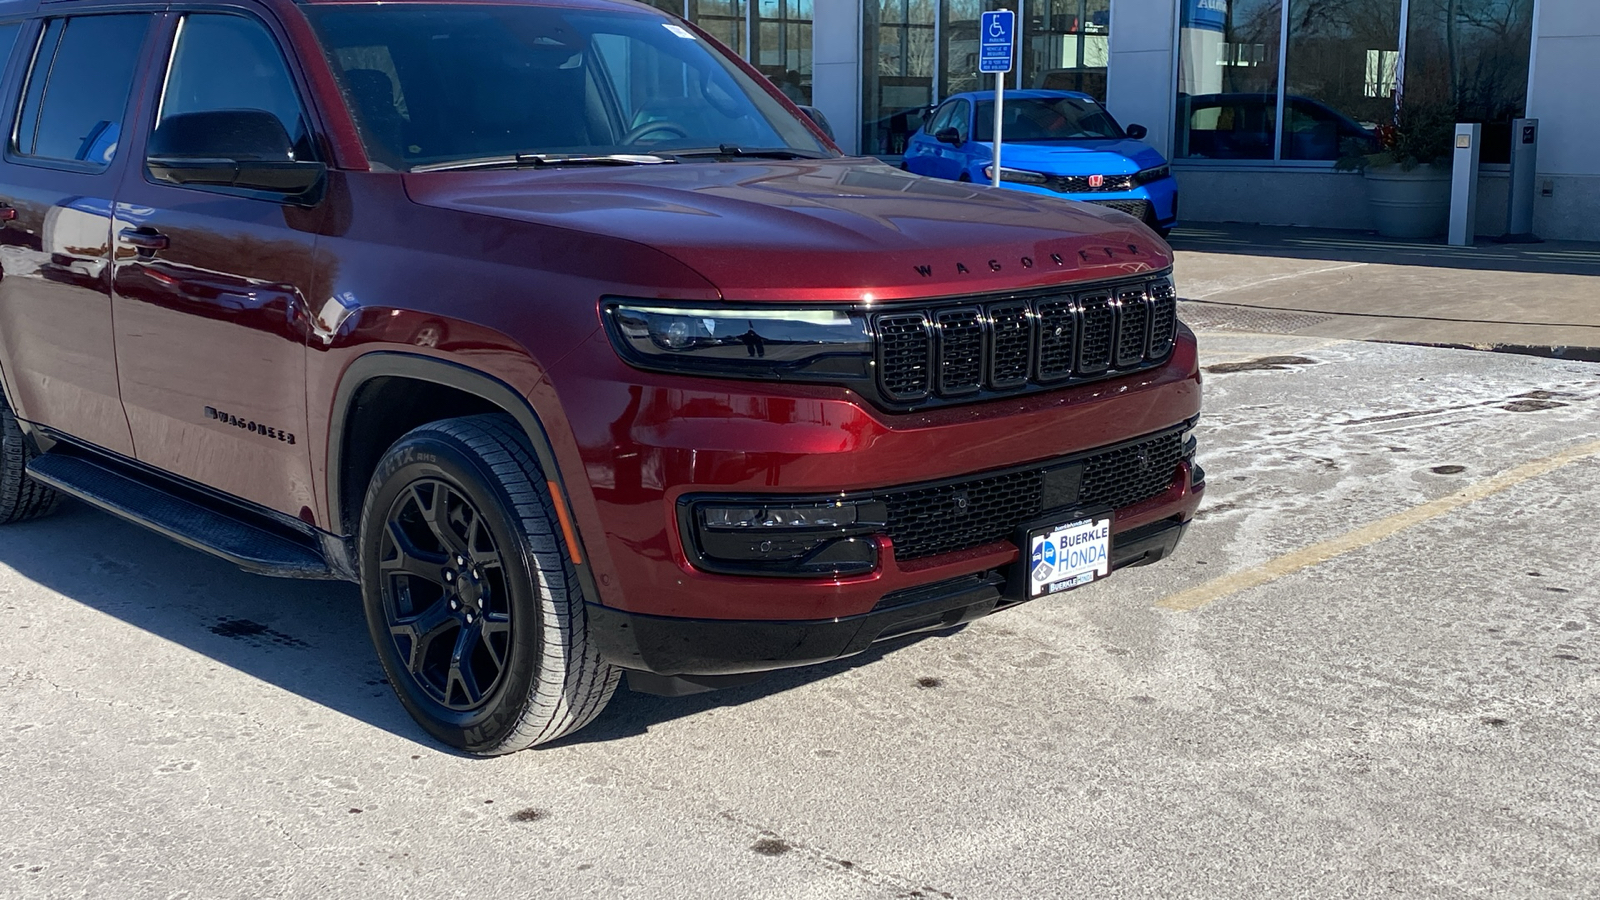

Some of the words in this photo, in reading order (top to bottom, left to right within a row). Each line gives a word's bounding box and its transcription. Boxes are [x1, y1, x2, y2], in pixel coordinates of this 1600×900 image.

[913, 244, 1142, 278] WAGONEER
[218, 410, 297, 445] WAGONEER
[1060, 526, 1108, 550] BUERKLE
[1058, 543, 1107, 573] HONDA
